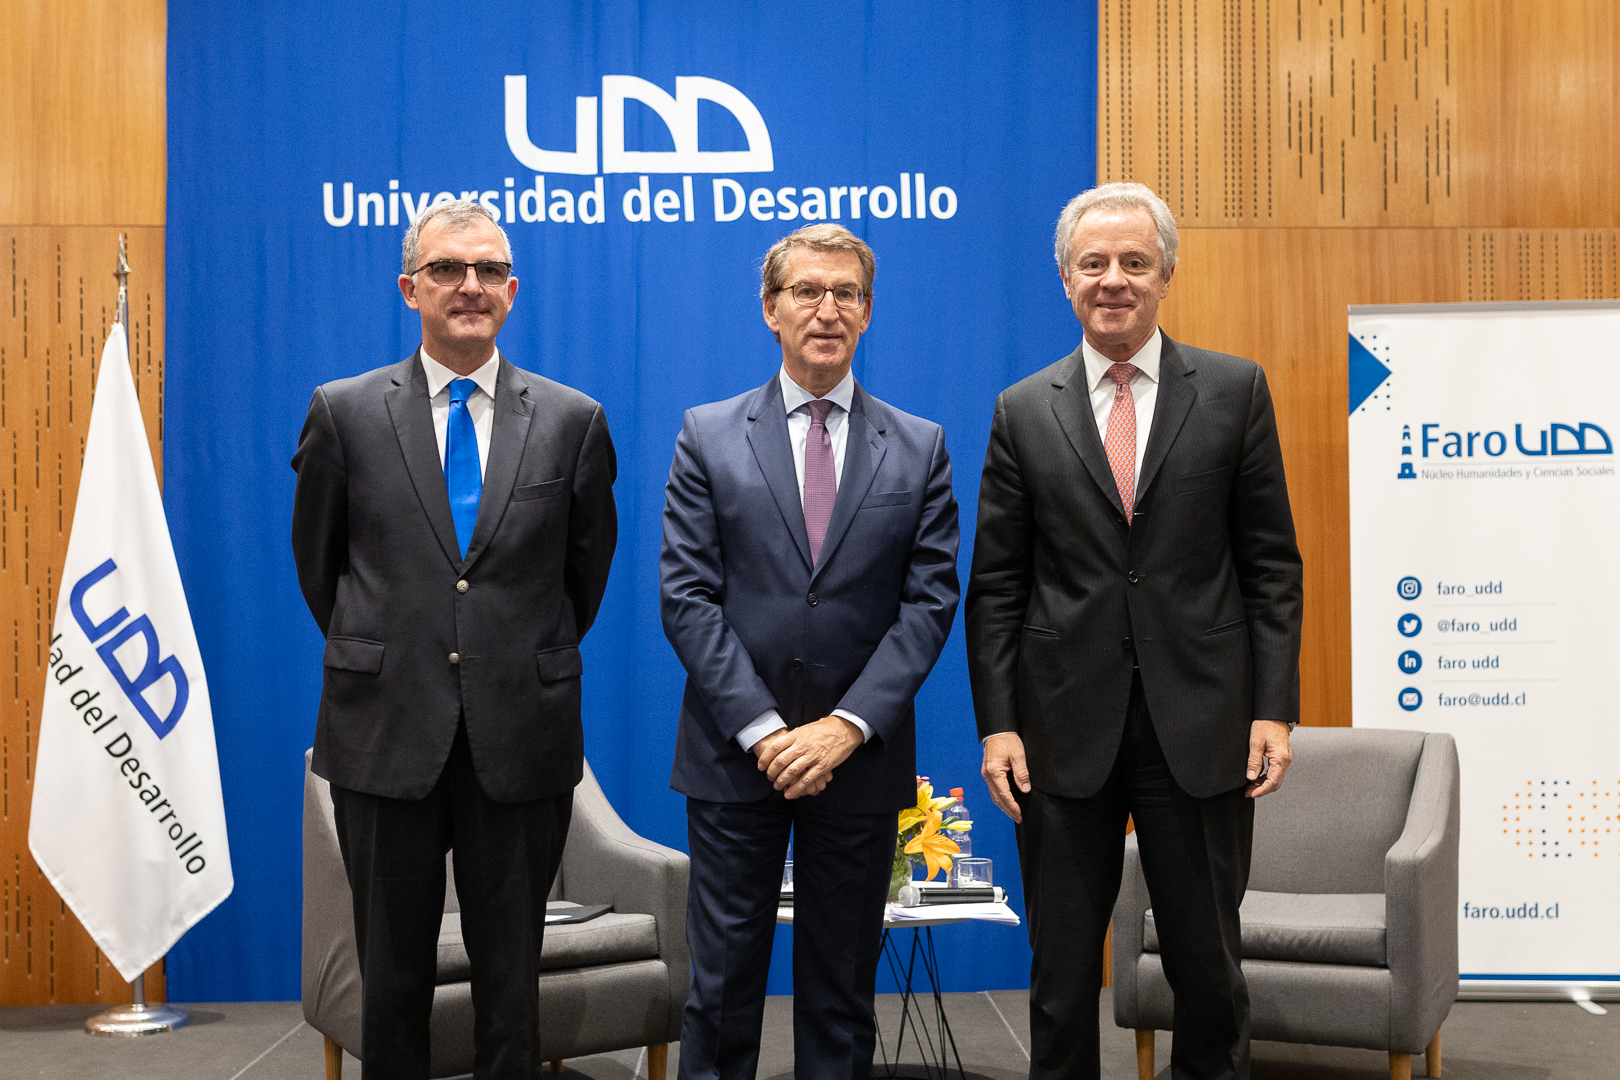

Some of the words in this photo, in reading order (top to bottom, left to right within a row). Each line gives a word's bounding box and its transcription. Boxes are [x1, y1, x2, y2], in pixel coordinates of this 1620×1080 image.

[622, 175, 695, 223] del
[712, 172, 958, 222] Desarrollo
[1422, 423, 1508, 458] Faro
[1421, 469, 1454, 480] Núcleo
[1456, 467, 1523, 479] Humanidades
[1525, 470, 1531, 481] y
[1533, 466, 1574, 477] Ciencias
[1576, 465, 1615, 477] Sociales
[1437, 581, 1503, 598] faro_udd
[1437, 618, 1518, 635] @faro_udd
[1438, 656, 1467, 670] faro
[1472, 655, 1500, 669] udd
[1438, 692, 1526, 707] faro@udd.cl
[69, 690, 118, 735] del
[104, 732, 206, 875] Desarrollo
[1463, 902, 1560, 919] faro.udd.cl
